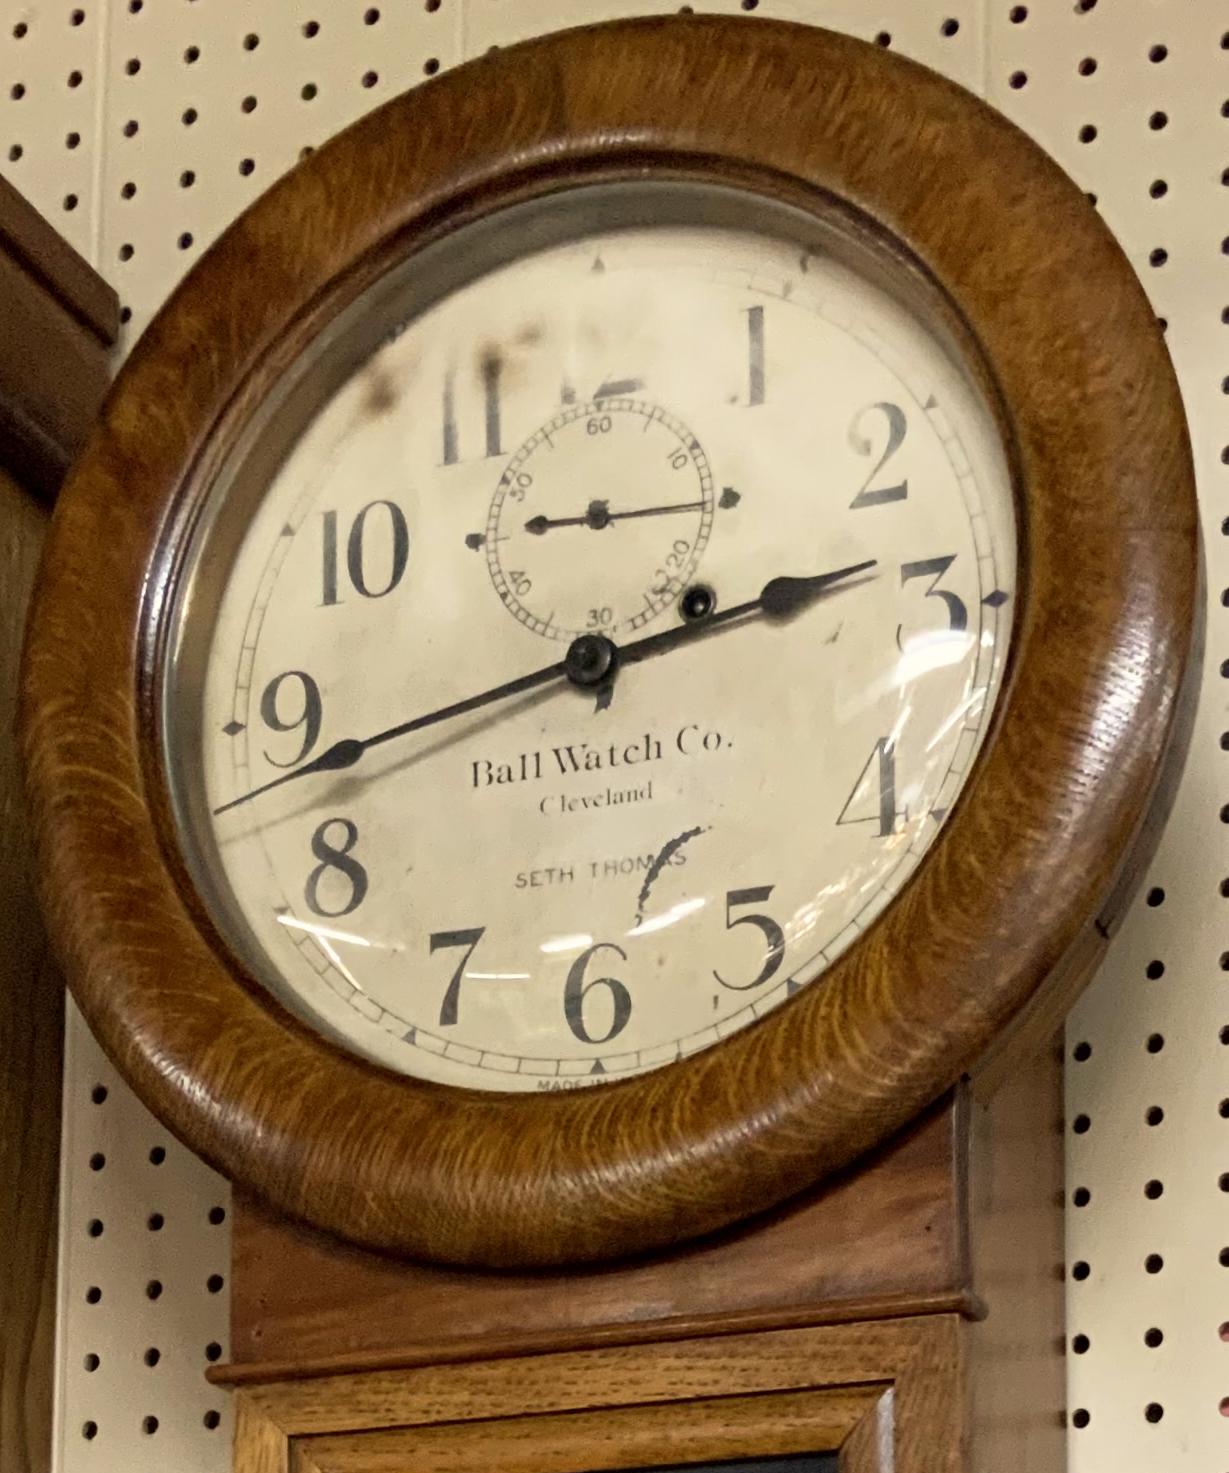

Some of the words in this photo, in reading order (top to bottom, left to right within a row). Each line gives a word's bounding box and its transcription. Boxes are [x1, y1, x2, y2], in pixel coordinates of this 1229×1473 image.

[586, 416, 612, 436] 60
[667, 447, 688, 470] 10
[848, 402, 908, 509] 2
[509, 473, 533, 503] 50
[316, 500, 411, 607] 10
[508, 570, 533, 597] 40
[586, 607, 613, 628] 30
[895, 553, 968, 655] 3
[260, 671, 323, 769] 9
[472, 752, 543, 788] Ball
[551, 733, 662, 775] Watch
[676, 724, 734, 755] Co.
[539, 780, 653, 818] Cleveland
[836, 736, 910, 838] 4
[304, 818, 369, 918] 8
[514, 867, 575, 889] SETH
[430, 927, 487, 1027] 7
[713, 885, 786, 991] 5
[563, 943, 632, 1045] 6
